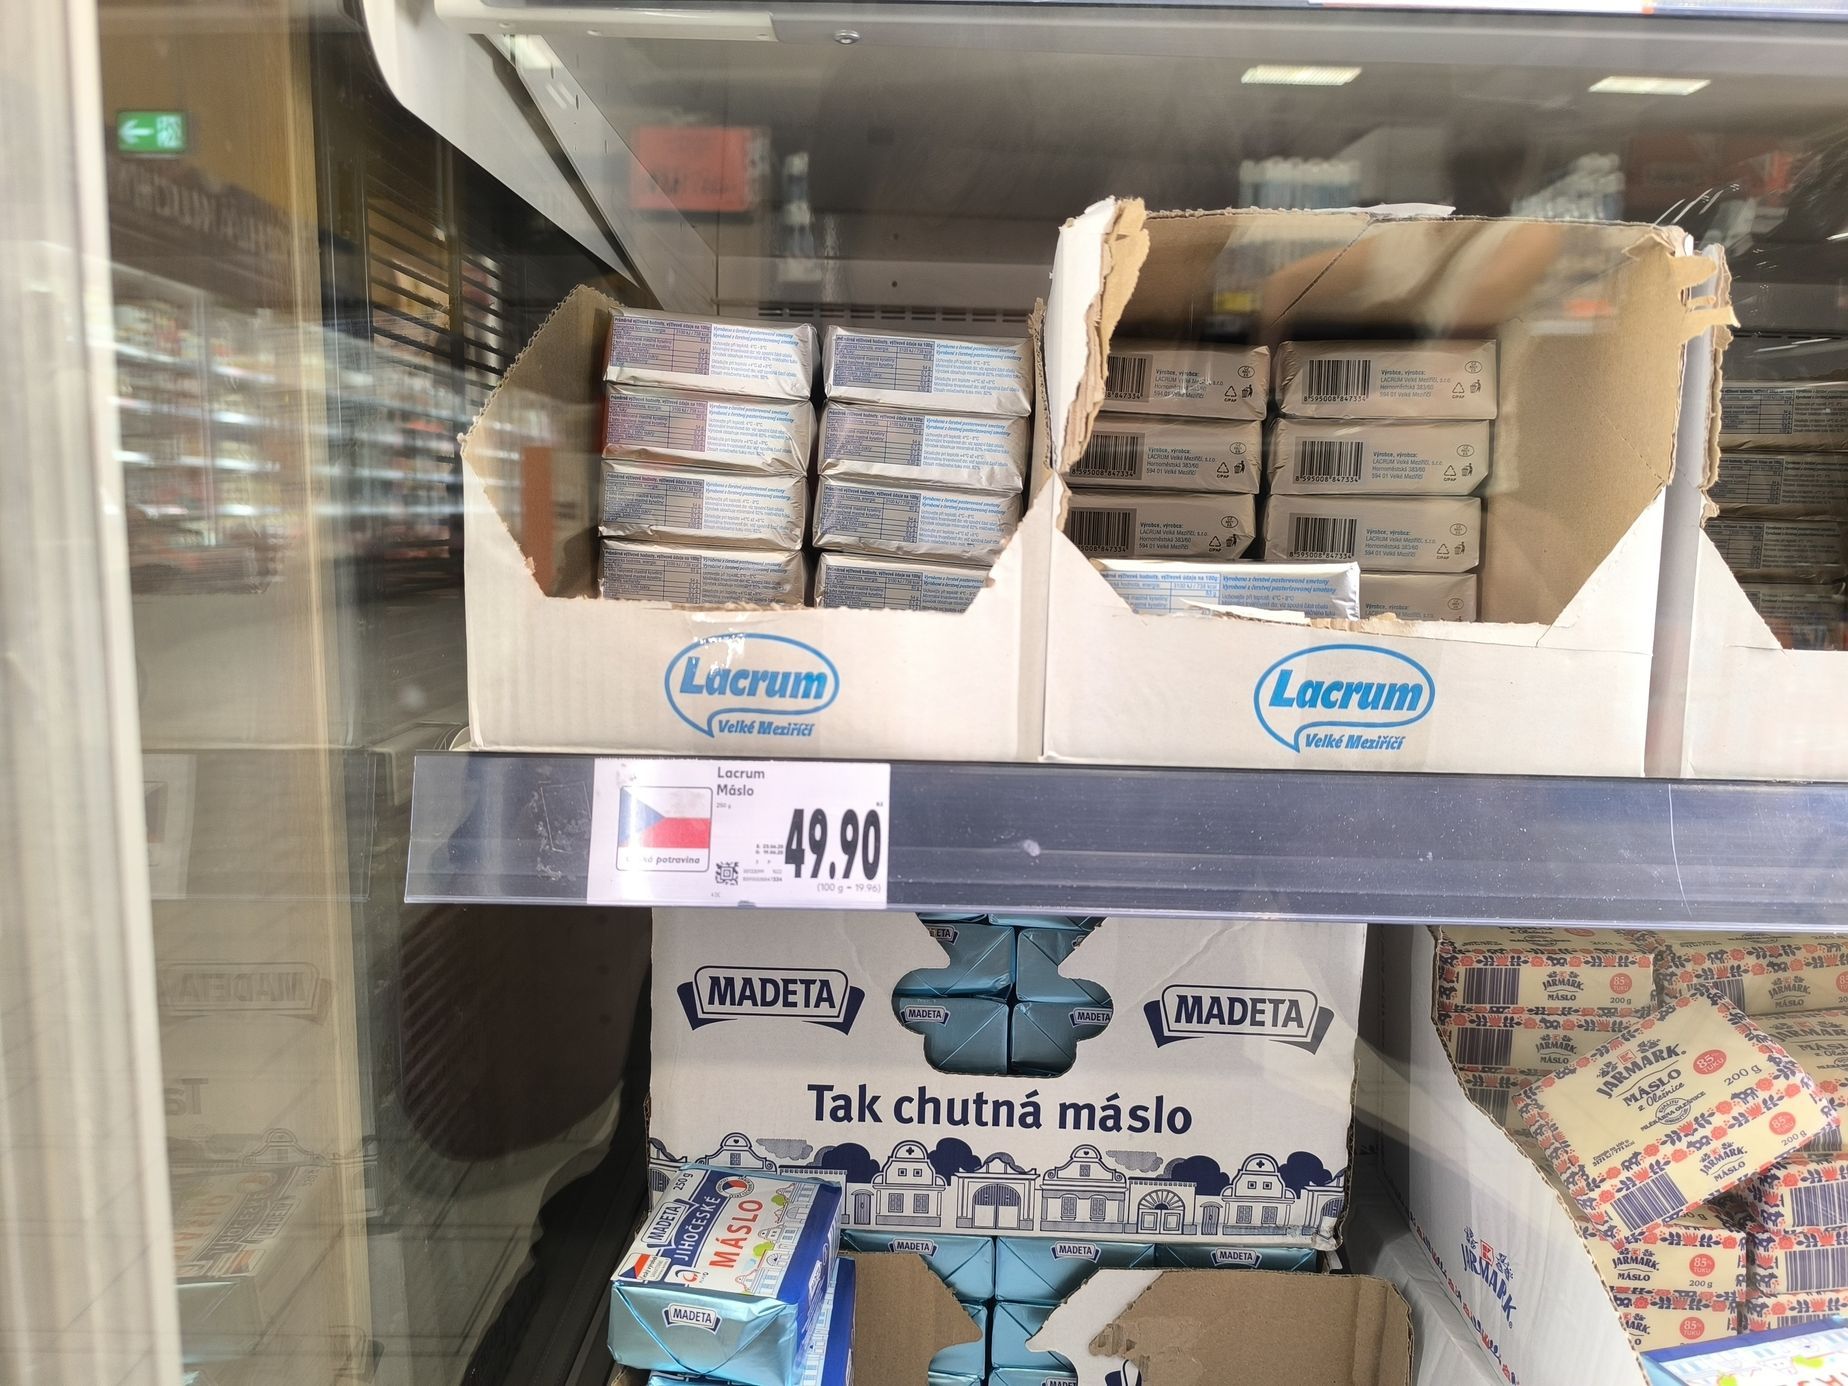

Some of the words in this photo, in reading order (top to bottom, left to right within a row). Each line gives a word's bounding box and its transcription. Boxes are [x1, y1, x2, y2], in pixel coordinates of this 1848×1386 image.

[679, 656, 828, 700] Lacrum
[1268, 669, 1424, 712] Lacrum
[718, 720, 756, 734] Velké
[757, 721, 815, 737] Meziříčí
[1305, 733, 1344, 749] Velké
[1345, 735, 1406, 750] Meziříčí
[717, 766, 765, 779] Lacrum
[716, 784, 754, 796] Máslo
[785, 808, 881, 881] 49.90
[656, 856, 700, 865] potravina
[1542, 978, 1584, 990] JARMARK
[1768, 984, 1811, 999] JARMARK
[708, 975, 836, 1010] MADETA
[1547, 993, 1576, 1001] MÁSLO
[1775, 1000, 1804, 1008] MÁSLO
[908, 1009, 942, 1020] MADETA
[1078, 1012, 1110, 1022] MADETA
[1174, 995, 1304, 1030] MADETA
[1536, 1040, 1578, 1054] JARMARK
[1540, 1056, 1569, 1064] MÁSLO
[1703, 1058, 1724, 1072] TUKU
[1596, 1044, 1684, 1100] JARMARK
[1724, 1068, 1748, 1086] 200
[1751, 1062, 1763, 1074] g
[1622, 1068, 1682, 1107] MÁSLO
[1646, 1082, 1685, 1107] Olešnice
[807, 1084, 882, 1123] Tak
[893, 1091, 1043, 1130] chutná
[1058, 1091, 1193, 1134] máslo
[1781, 1133, 1798, 1146] 200
[1699, 1144, 1748, 1176] JARMARK
[1714, 1160, 1746, 1182] MÁSLO
[672, 1178, 689, 1191] 250
[685, 1172, 694, 1180] g
[648, 1204, 682, 1242] MADETA
[1698, 1212, 1708, 1221] g
[674, 1194, 720, 1261] JIHOČESKÉ
[708, 1199, 764, 1269] MÁSLO
[896, 1241, 932, 1252] MADETA
[1058, 1244, 1095, 1256] MADETA
[1218, 1250, 1256, 1262] MADETA
[1612, 1255, 1659, 1271] JARMARK
[1461, 1243, 1517, 1322] JARMARK
[1617, 1272, 1650, 1282] MÁSLO
[672, 1308, 712, 1324] MADETA
